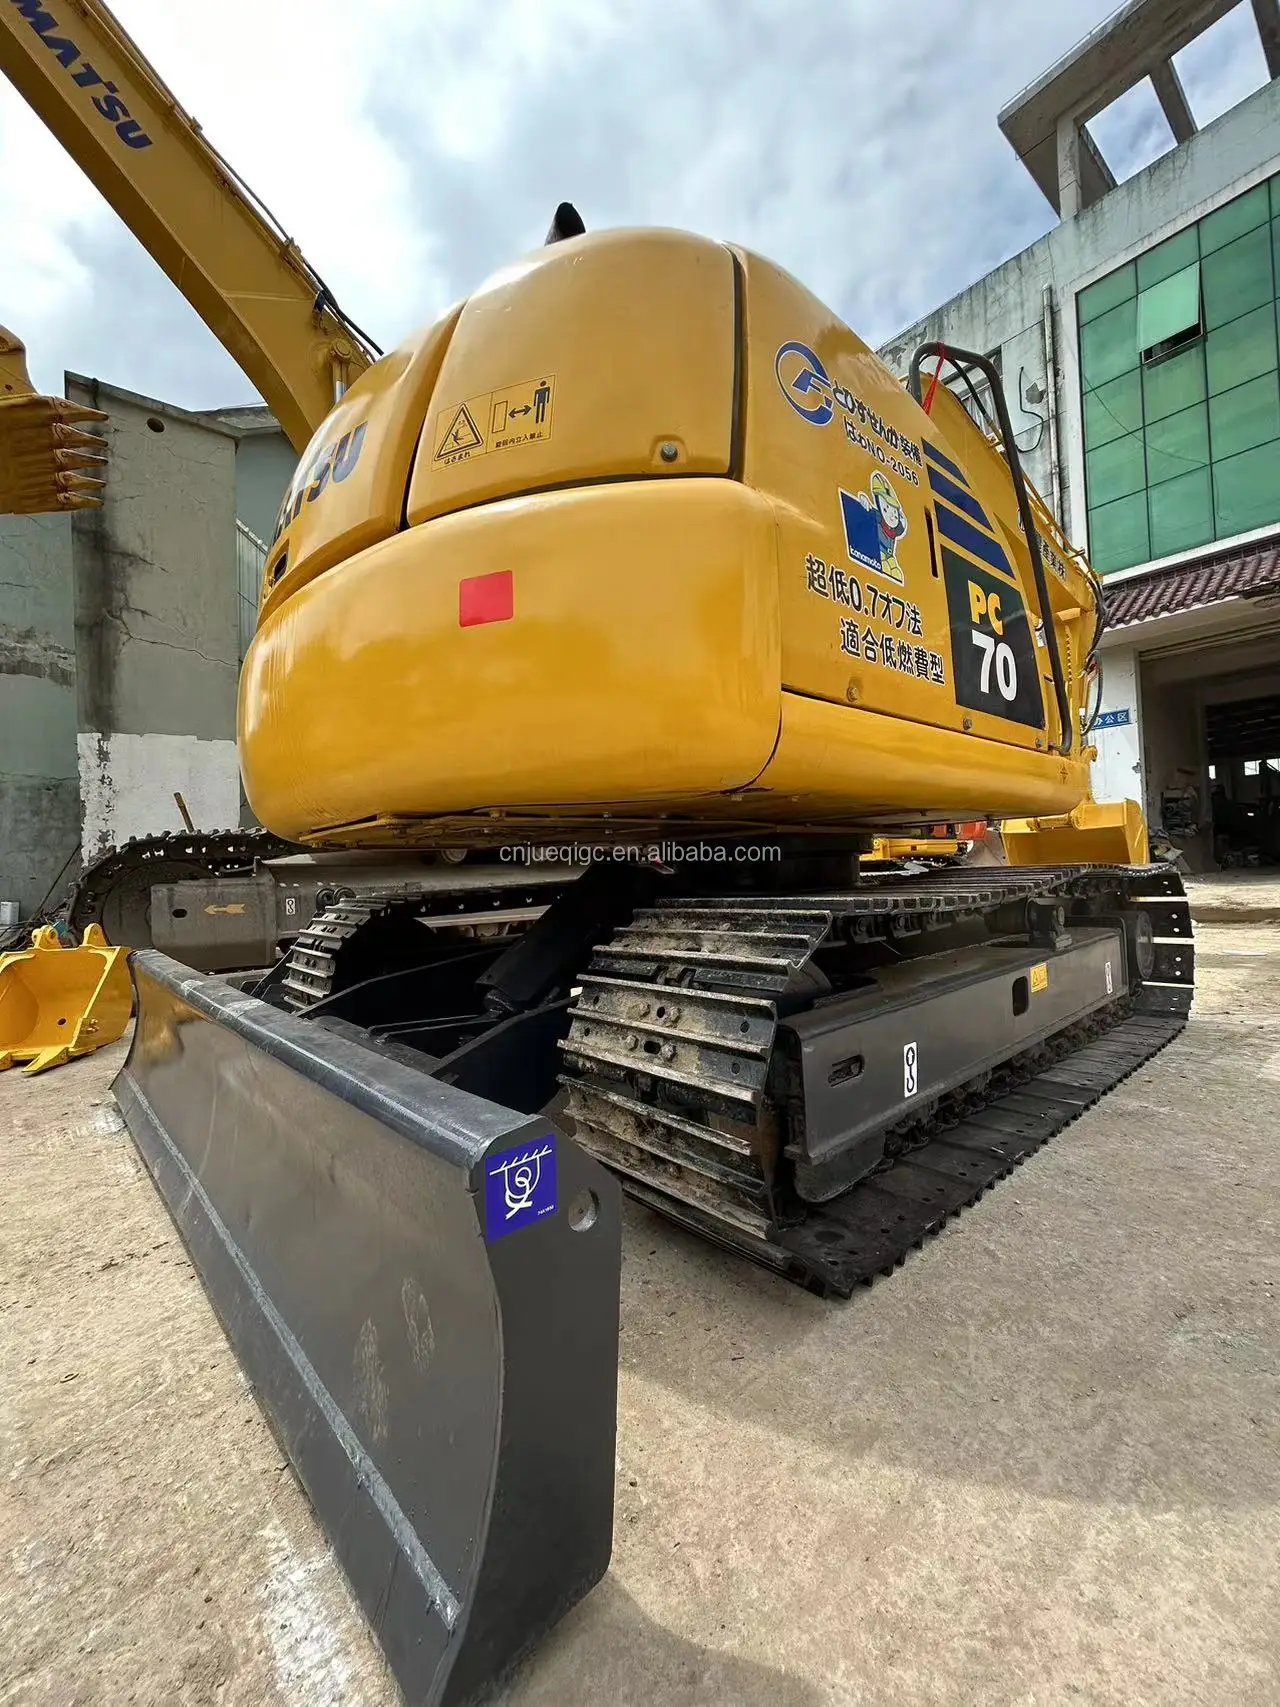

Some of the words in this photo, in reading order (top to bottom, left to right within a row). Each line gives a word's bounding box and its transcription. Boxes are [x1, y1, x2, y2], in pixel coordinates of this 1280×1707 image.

[967, 579, 1004, 636] PC
[840, 617, 945, 685] 適合低燃費型
[971, 628, 1018, 702] 70
